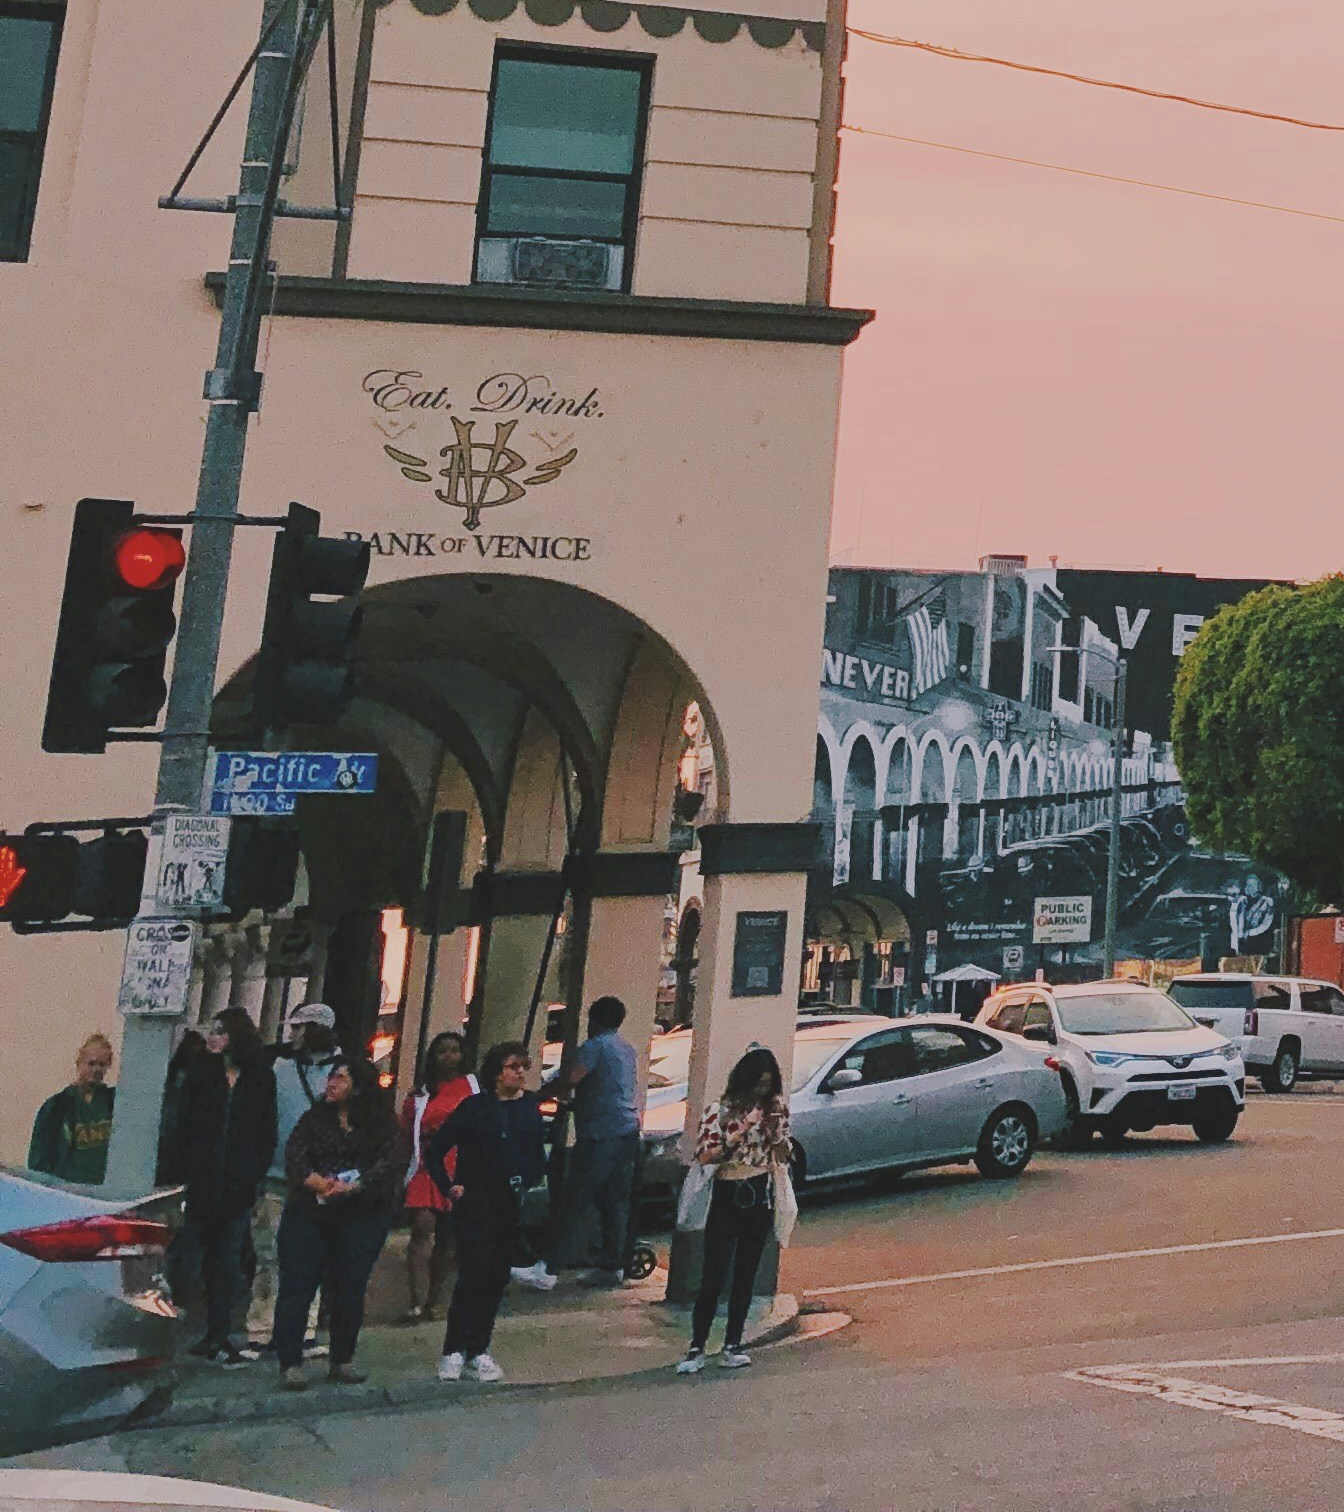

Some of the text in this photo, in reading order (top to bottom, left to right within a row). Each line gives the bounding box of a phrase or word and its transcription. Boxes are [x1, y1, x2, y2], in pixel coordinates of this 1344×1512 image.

[361, 369, 605, 419] Eat. Drink.
[441, 536, 467, 554] OF
[472, 534, 592, 561] VENICE
[229, 757, 321, 784] Pacific
[174, 818, 221, 833] DIAGONAL
[172, 832, 221, 849] CROSSING
[1040, 902, 1085, 915] PUBLIC
